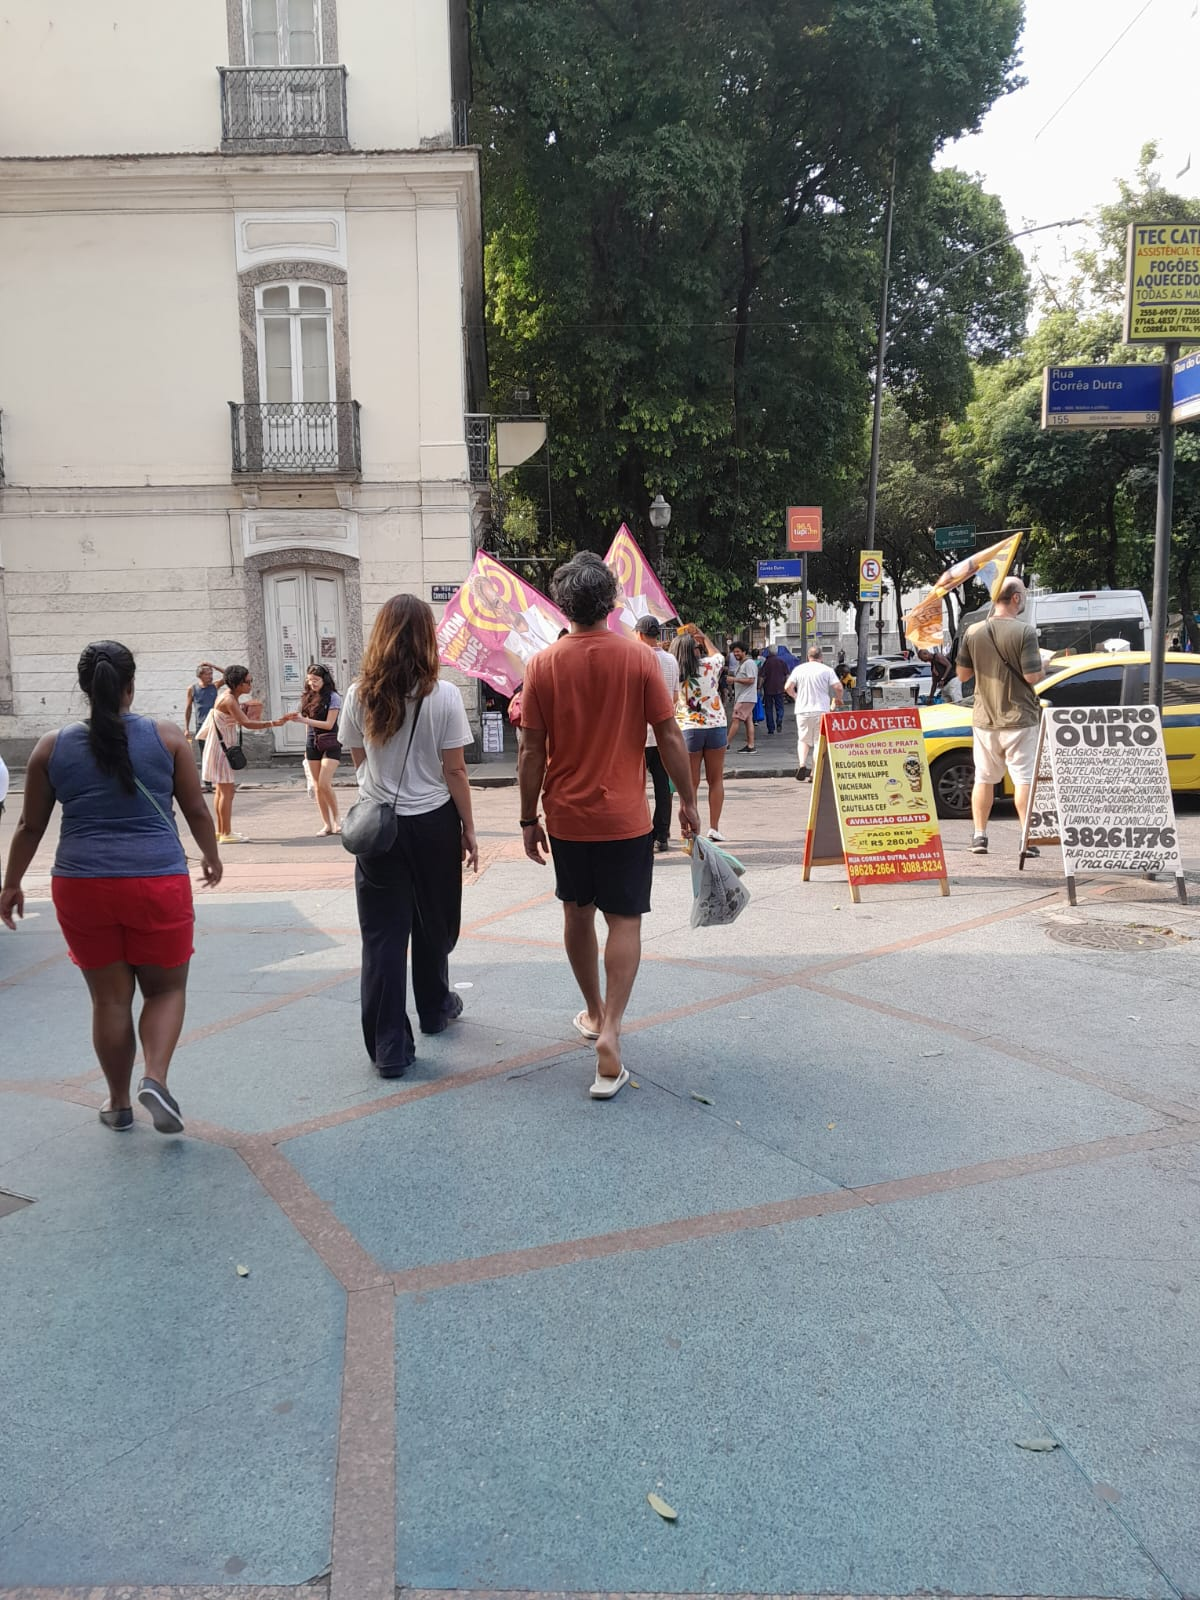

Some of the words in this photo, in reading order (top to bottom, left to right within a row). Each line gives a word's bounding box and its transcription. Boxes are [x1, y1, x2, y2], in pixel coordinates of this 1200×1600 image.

[1138, 229, 1166, 245] TEC
[1171, 229, 1200, 244] CAT
[1150, 257, 1199, 273] FOGÕES
[1136, 289, 1168, 300] TODAS
[1171, 289, 1183, 299] AS
[1185, 289, 1200, 298] MA
[1053, 369, 1074, 379] Rua
[1052, 380, 1089, 391] Corrêa
[1093, 380, 1123, 390] Dutra
[1053, 416, 1069, 424] 155
[1145, 414, 1157, 423] 99
[1052, 708, 1155, 724] COMPRO
[831, 716, 857, 731] ALÔ
[860, 715, 917, 730] CATETE!
[1055, 725, 1157, 747] OURO
[834, 742, 864, 750] COMPRO
[1102, 747, 1162, 756] BRILHANTES
[835, 760, 866, 769] RELÓGIOS
[868, 759, 888, 768] ROLEX
[837, 772, 856, 780] PATEK
[858, 770, 889, 779] PHILLIPPE
[1057, 776, 1095, 784] OBJETOS
[840, 793, 879, 801] BRILHANTES
[842, 804, 874, 812] CAUTELAS
[849, 815, 894, 825] AVALIAÇÃO
[1102, 816, 1111, 825] A
[887, 837, 919, 846] 280,00
[1065, 849, 1083, 858] RUA
